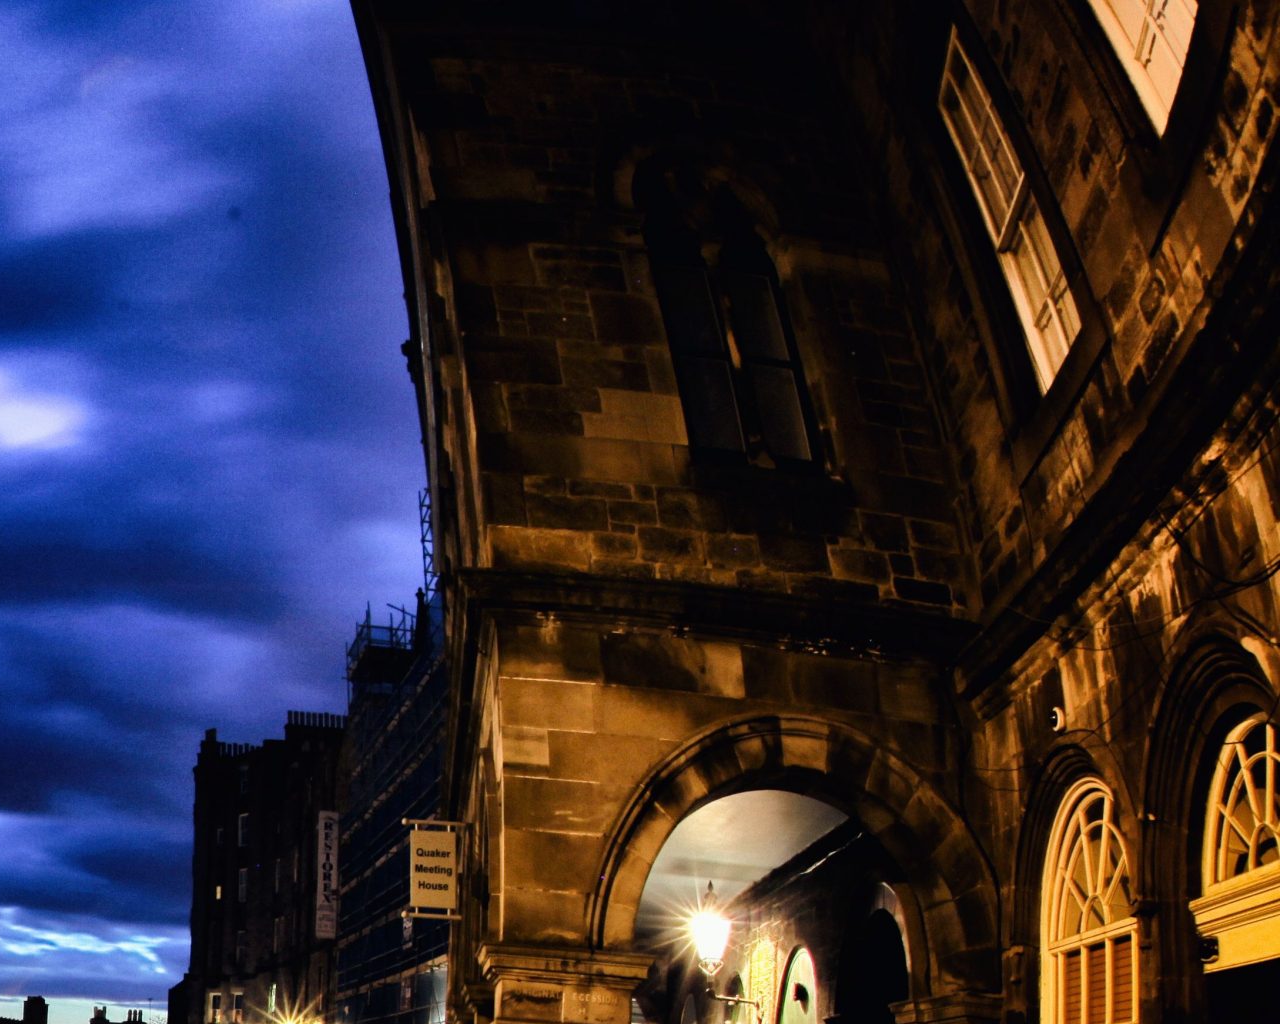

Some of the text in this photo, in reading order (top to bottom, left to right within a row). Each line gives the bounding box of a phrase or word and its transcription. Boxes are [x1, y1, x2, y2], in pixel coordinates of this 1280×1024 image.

[416, 848, 451, 858] Quaker
[415, 864, 452, 877] Meeting
[418, 880, 449, 890] House
